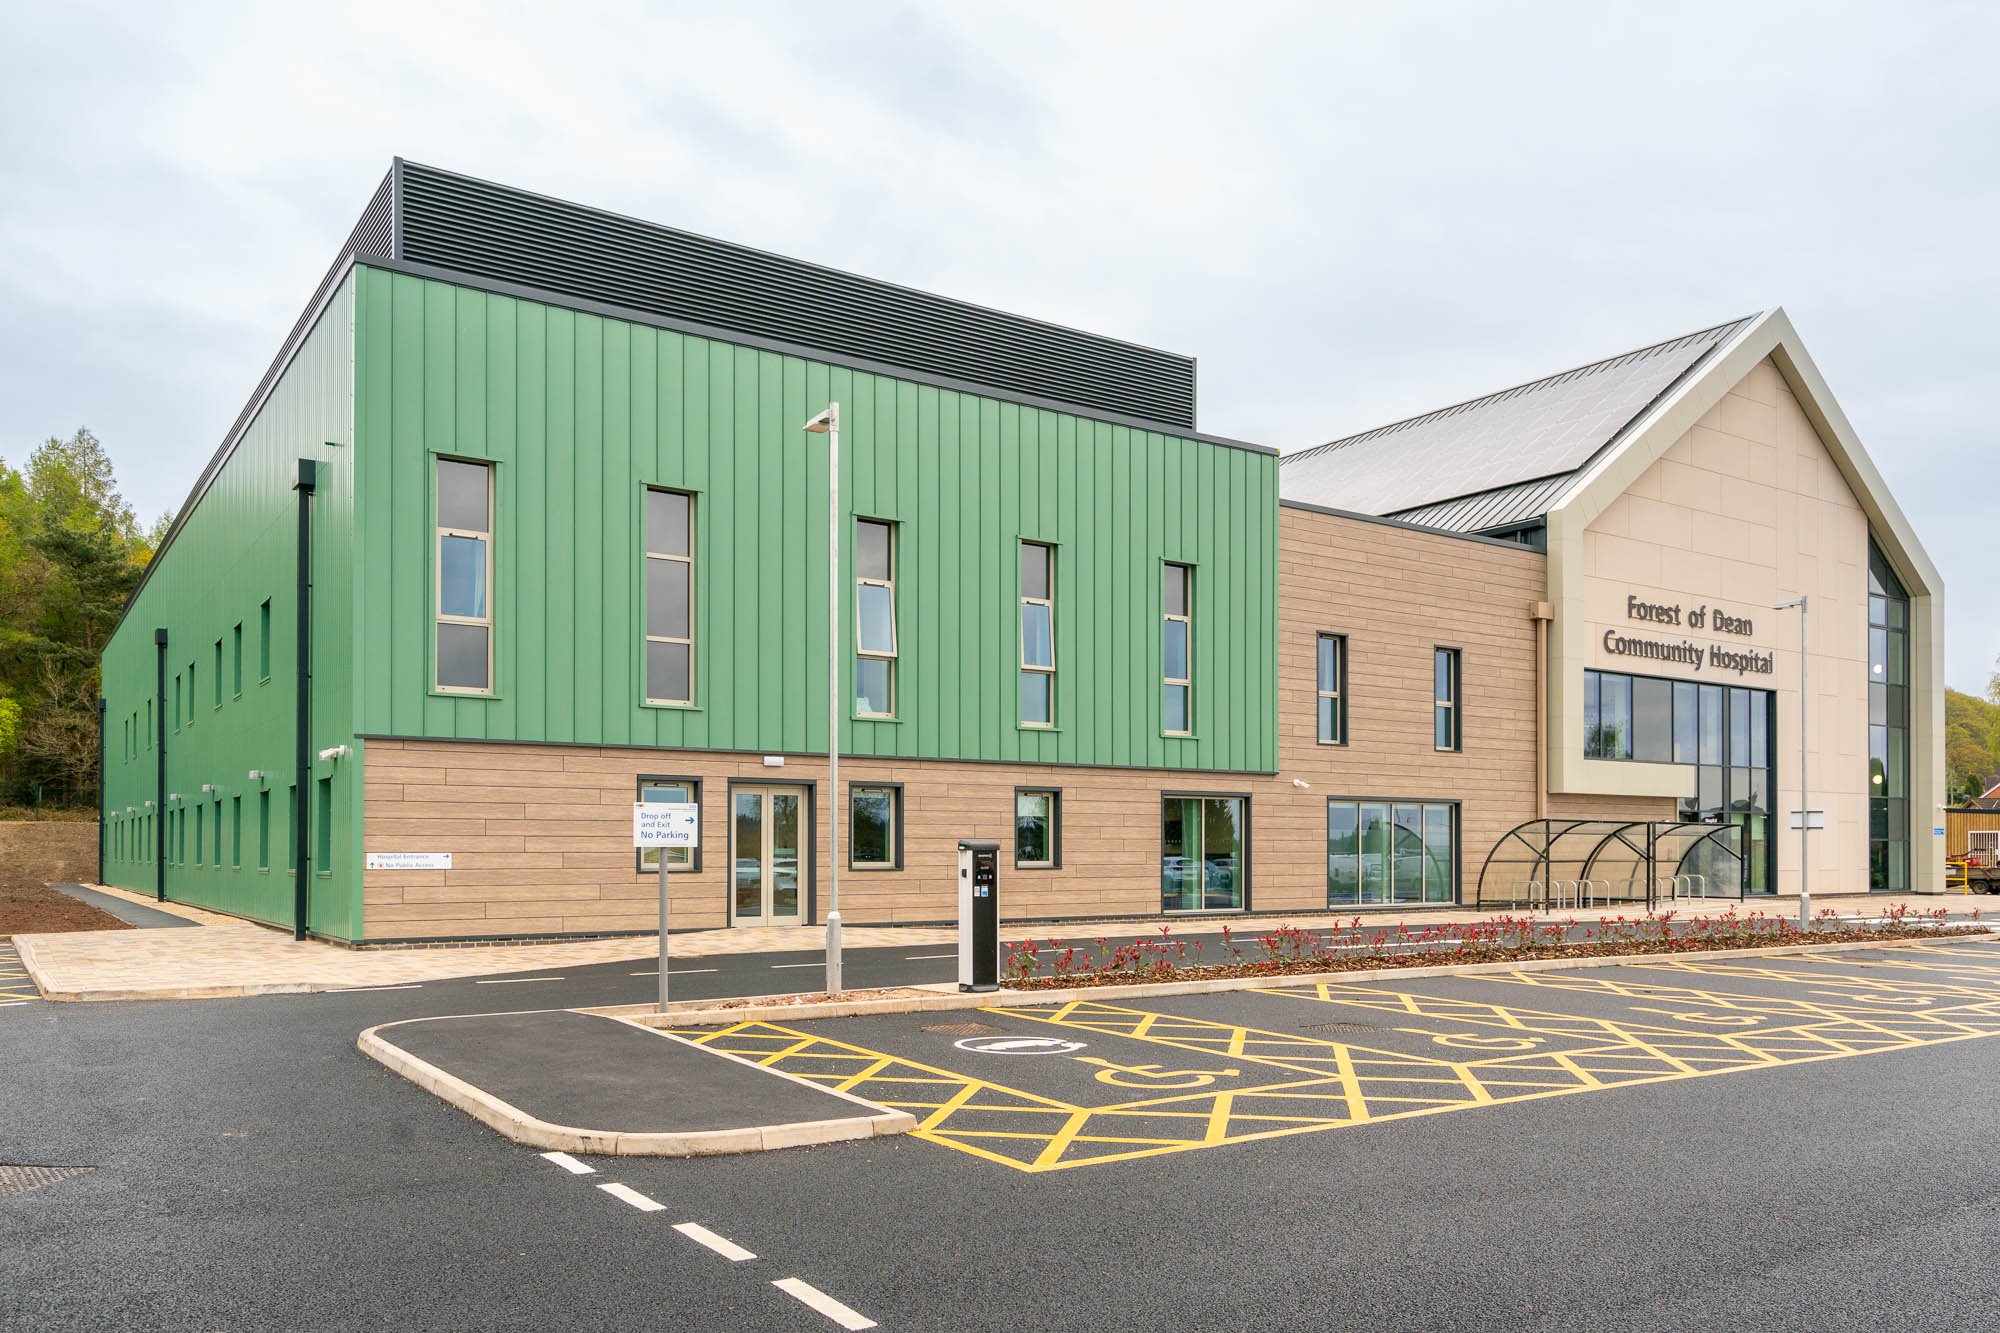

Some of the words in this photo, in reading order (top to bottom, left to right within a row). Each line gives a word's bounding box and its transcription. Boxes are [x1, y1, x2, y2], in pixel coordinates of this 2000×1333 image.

[1627, 595, 1681, 625] Forest
[1688, 605, 1706, 628] of
[1713, 609, 1753, 635] Dean
[1603, 629, 1704, 671] Community
[1710, 644, 1773, 676] Hospital
[641, 812, 659, 820] Drop
[641, 831, 653, 839] No
[656, 831, 689, 840] Parking
